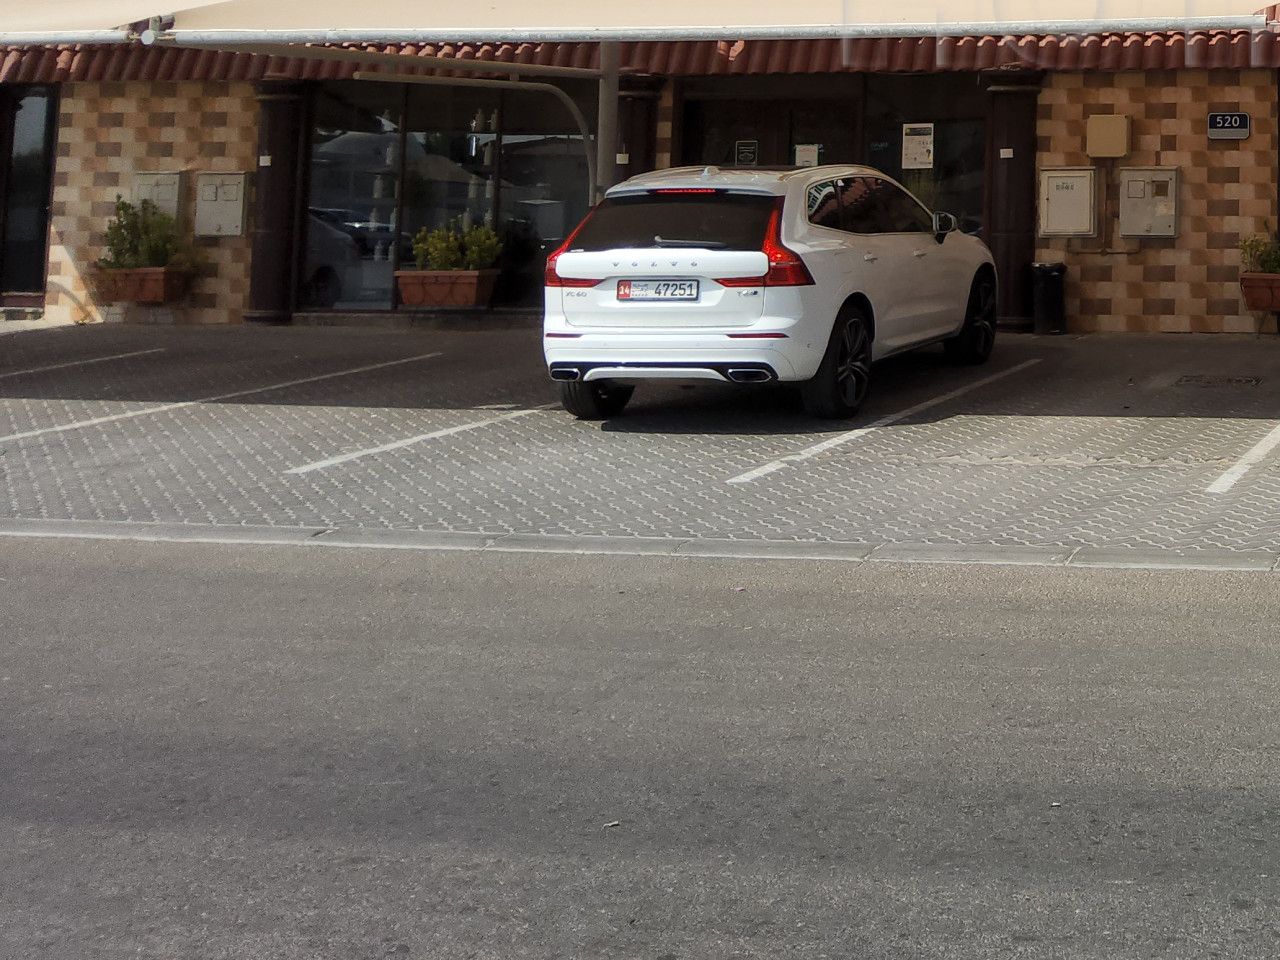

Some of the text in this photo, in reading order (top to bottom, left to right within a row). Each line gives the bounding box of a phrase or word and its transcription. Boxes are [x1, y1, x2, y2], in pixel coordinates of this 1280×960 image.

[1216, 116, 1241, 128] 520
[619, 285, 630, 295] 14
[654, 283, 695, 297] 47251
